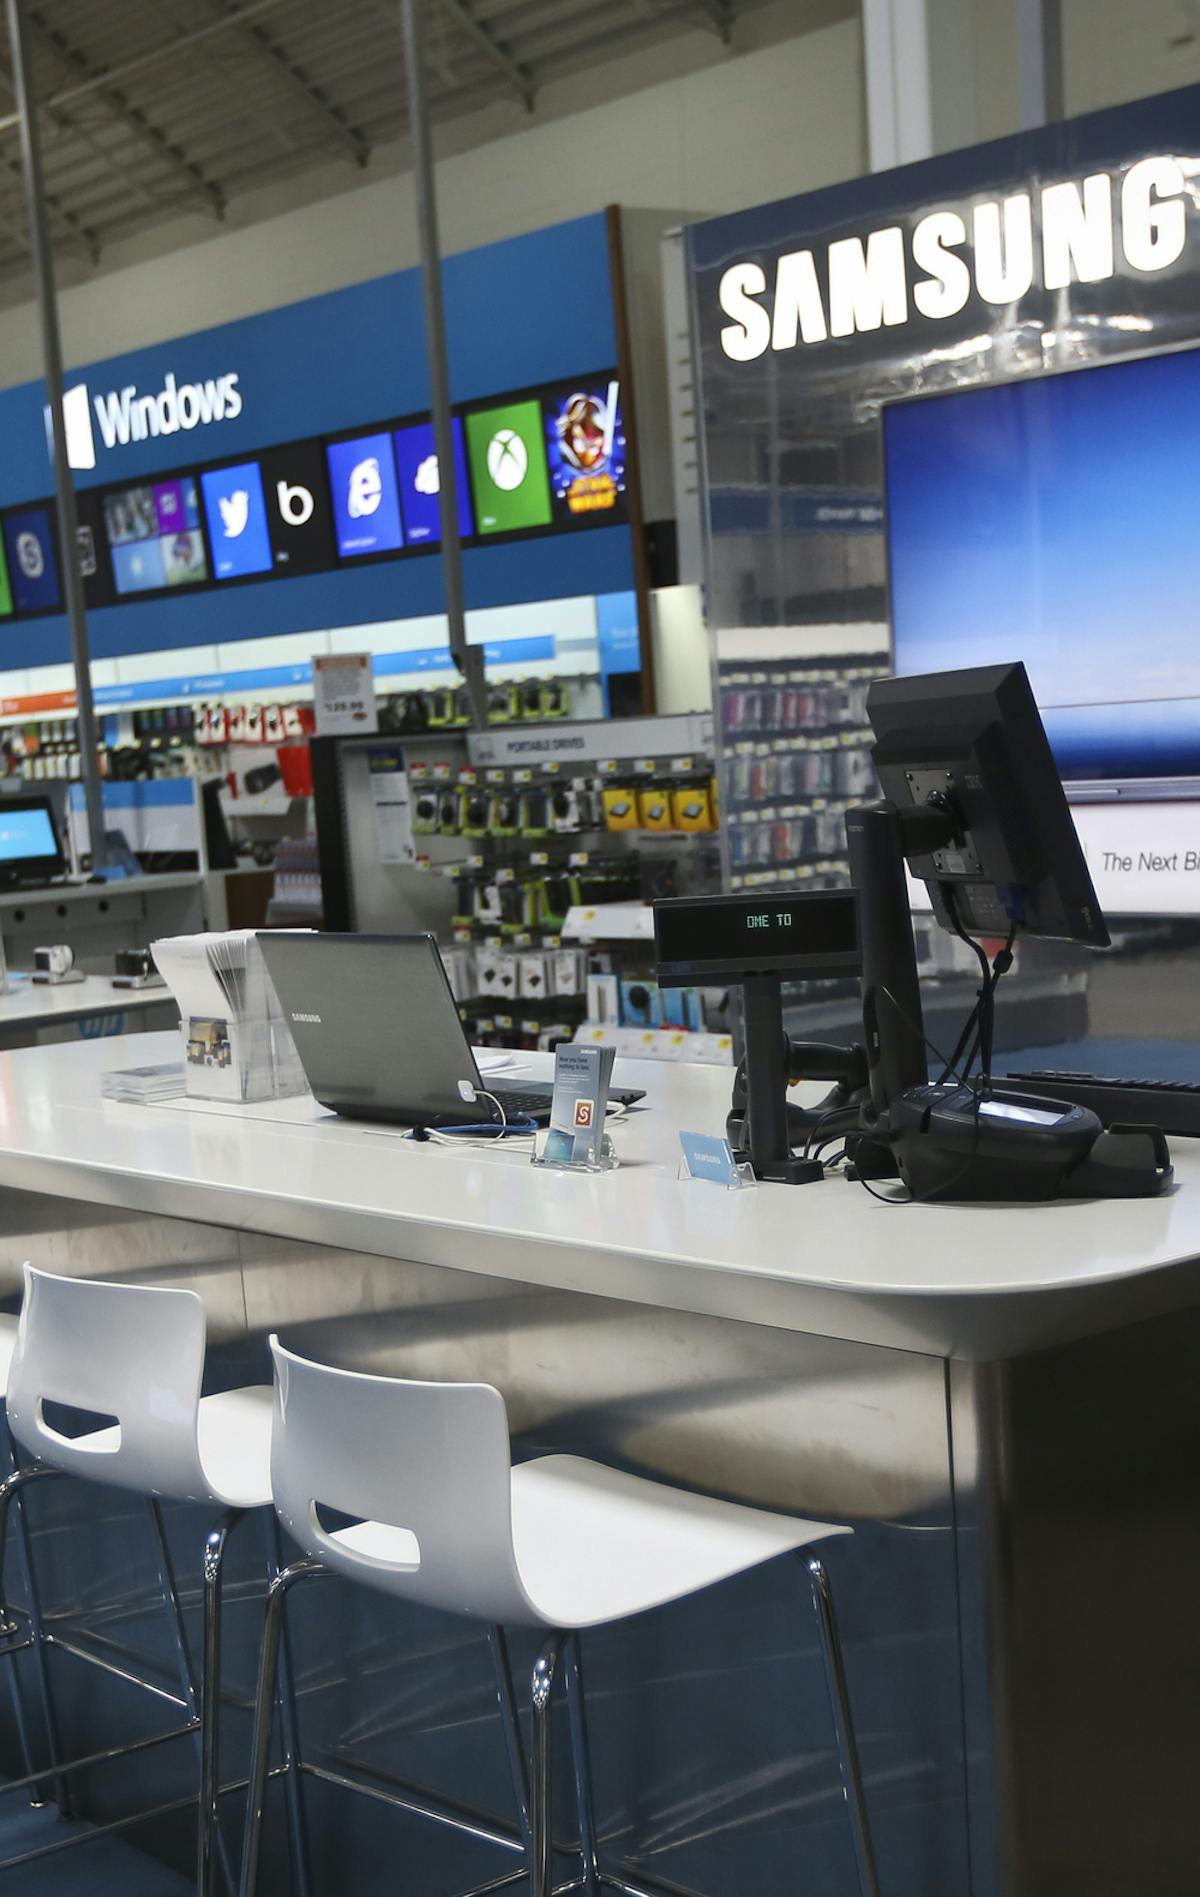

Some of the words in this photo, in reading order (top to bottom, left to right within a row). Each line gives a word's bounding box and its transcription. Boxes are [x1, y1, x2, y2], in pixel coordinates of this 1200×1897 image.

[719, 156, 1187, 362] SAMSUNG
[93, 372, 242, 449] Windows
[276, 480, 315, 526] b
[1102, 852, 1132, 872] The
[1137, 851, 1177, 872] Next
[776, 913, 792, 927] TO
[291, 1012, 322, 1023] SAMSUNG
[577, 1105, 590, 1123] S
